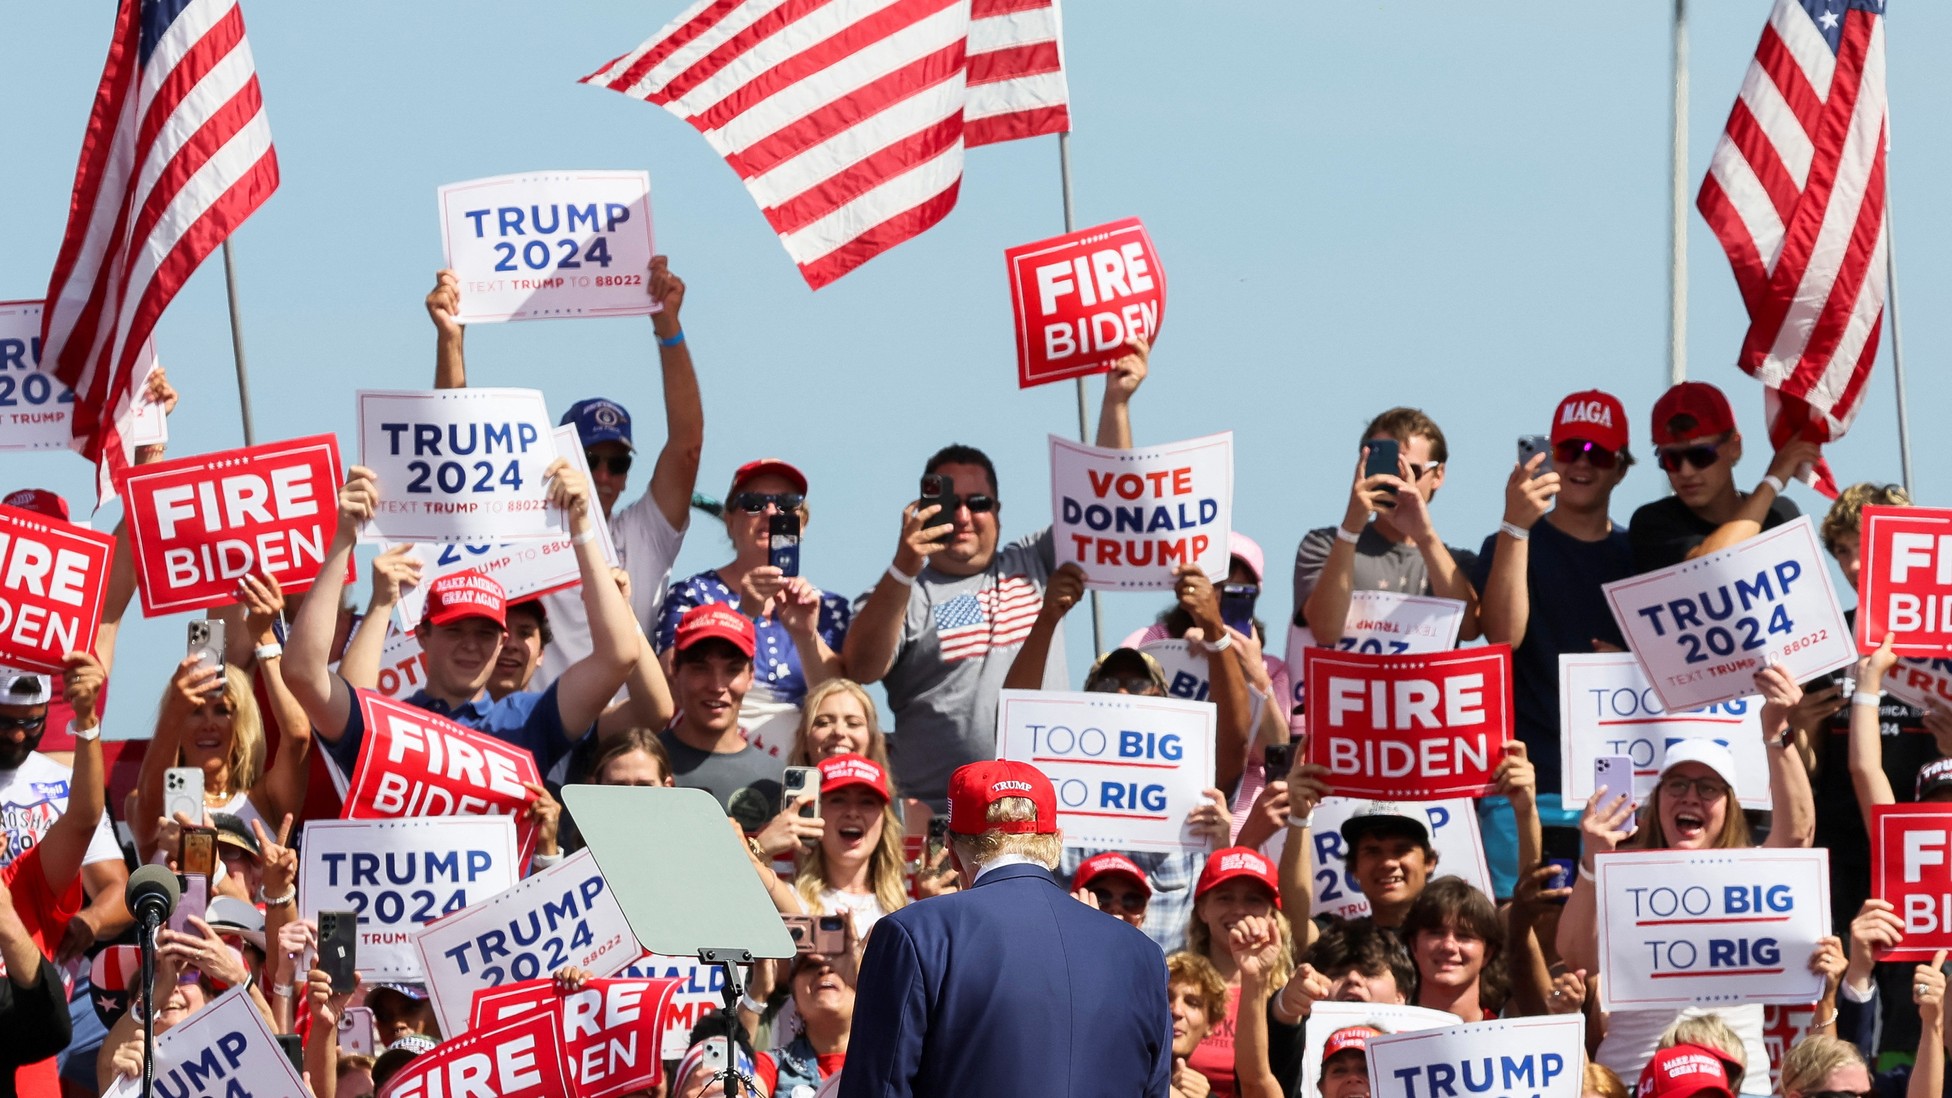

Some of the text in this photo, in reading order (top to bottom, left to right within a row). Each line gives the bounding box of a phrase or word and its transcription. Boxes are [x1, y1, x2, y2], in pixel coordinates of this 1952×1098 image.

[465, 203, 631, 238] TRUMP
[494, 236, 613, 272] 2024
[468, 274, 642, 293] TEXT TRUMP TO 88022
[1036, 241, 1154, 316] FIRE
[1044, 299, 1158, 361] BIDEN
[10, 412, 65, 425] TRUMP
[1560, 400, 1613, 428] MAGA
[381, 423, 538, 456] TRUMP
[406, 459, 524, 494] 2024
[1088, 466, 1192, 500] VOTE
[152, 463, 319, 541] FIRE
[380, 501, 418, 514] TEXT
[424, 502, 478, 515] TRUMP
[507, 499, 549, 514] 88022
[1062, 496, 1218, 533] DONALD
[164, 524, 326, 589] BIDEN
[1071, 534, 1209, 567] TRUMP
[1890, 532, 1952, 585] FI
[436, 577, 464, 592] MAKE
[442, 590, 473, 606] GREAT
[1638, 560, 1802, 637] TRUMP
[1356, 618, 1400, 634] TRUMP
[1677, 603, 1794, 665] 2024
[1667, 670, 1704, 687] TEXT
[1706, 658, 1757, 678] TRUMP
[1783, 629, 1829, 656] 88022
[1328, 672, 1486, 730] FIRE
[387, 715, 527, 800] FIRE
[1026, 724, 1184, 761] TOO BIG
[1329, 733, 1489, 779] BIDEN
[992, 780, 1032, 793] TRUMP
[1100, 781, 1167, 812] RIG
[322, 850, 492, 887] TRUMP
[344, 889, 467, 925] 2024
[1626, 884, 1794, 918] TOO BIG
[361, 932, 412, 946] TRUM
[444, 875, 605, 976] TRUMP
[480, 918, 595, 988] 2024
[582, 933, 623, 968] 88022
[1644, 937, 1781, 970] TO RIG
[1394, 1053, 1564, 1098] TRUMP
